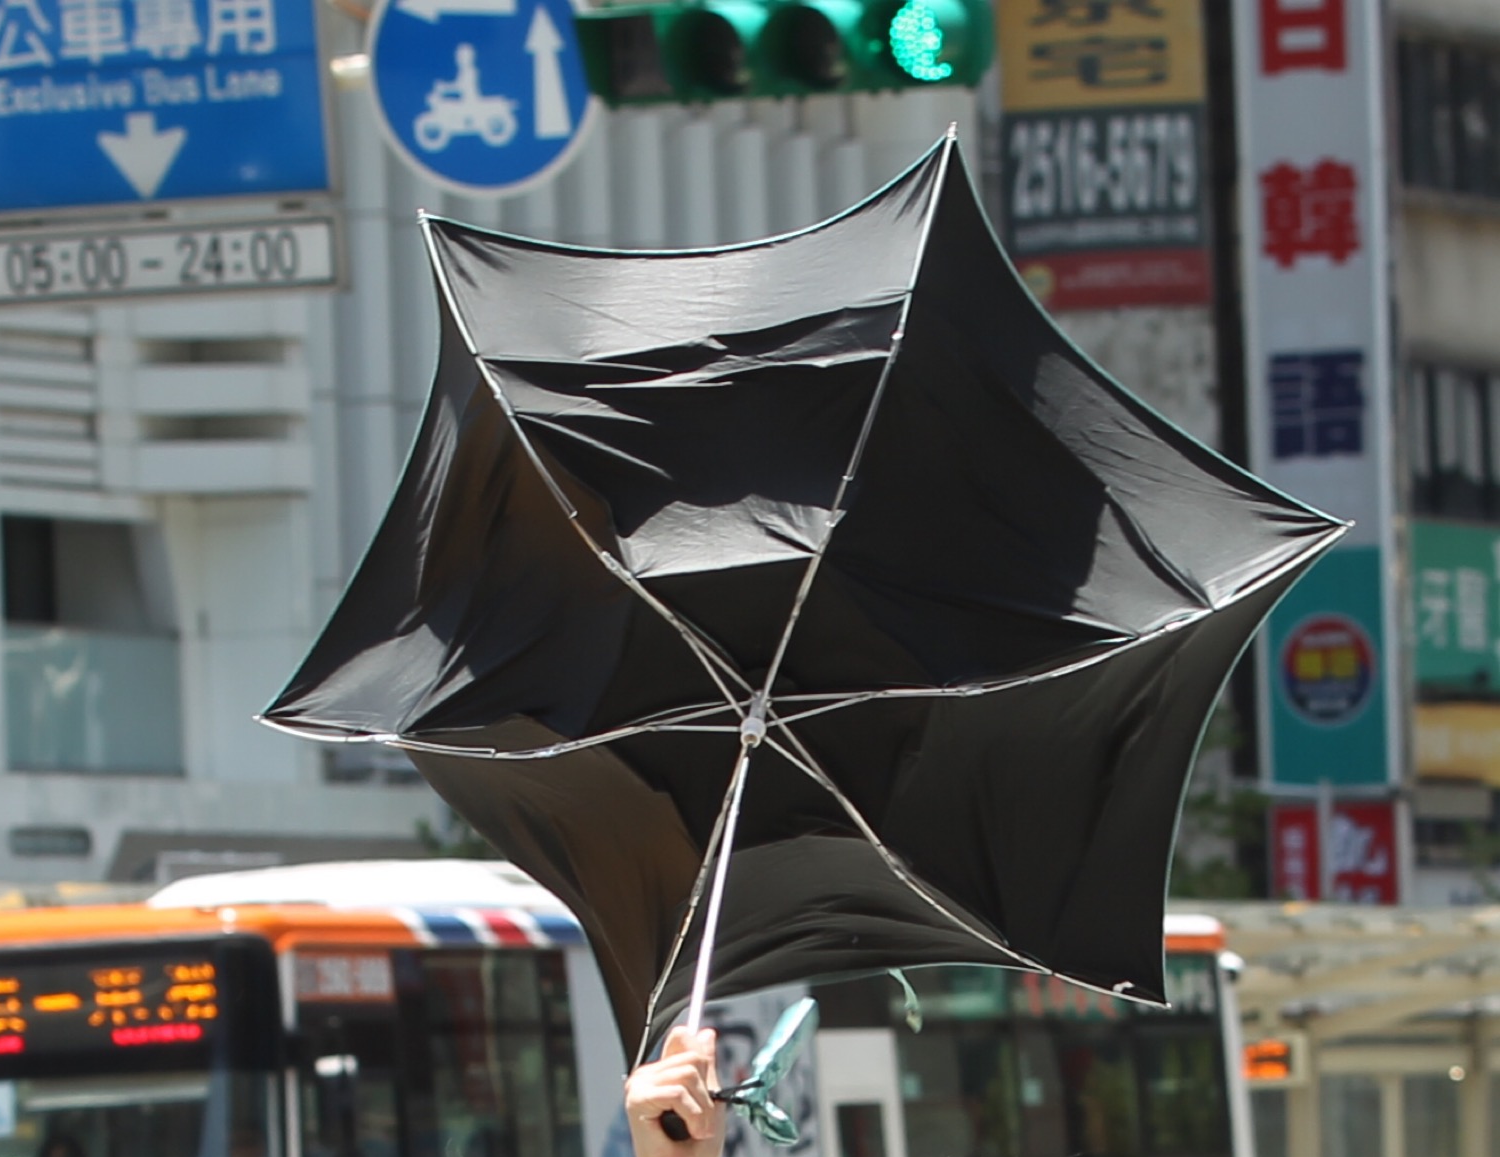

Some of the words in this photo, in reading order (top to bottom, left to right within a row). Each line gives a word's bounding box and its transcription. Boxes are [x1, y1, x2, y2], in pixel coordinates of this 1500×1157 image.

[142, 68, 198, 105] Bus
[204, 63, 280, 101] Lane
[1010, 114, 1196, 218] 2516-5679
